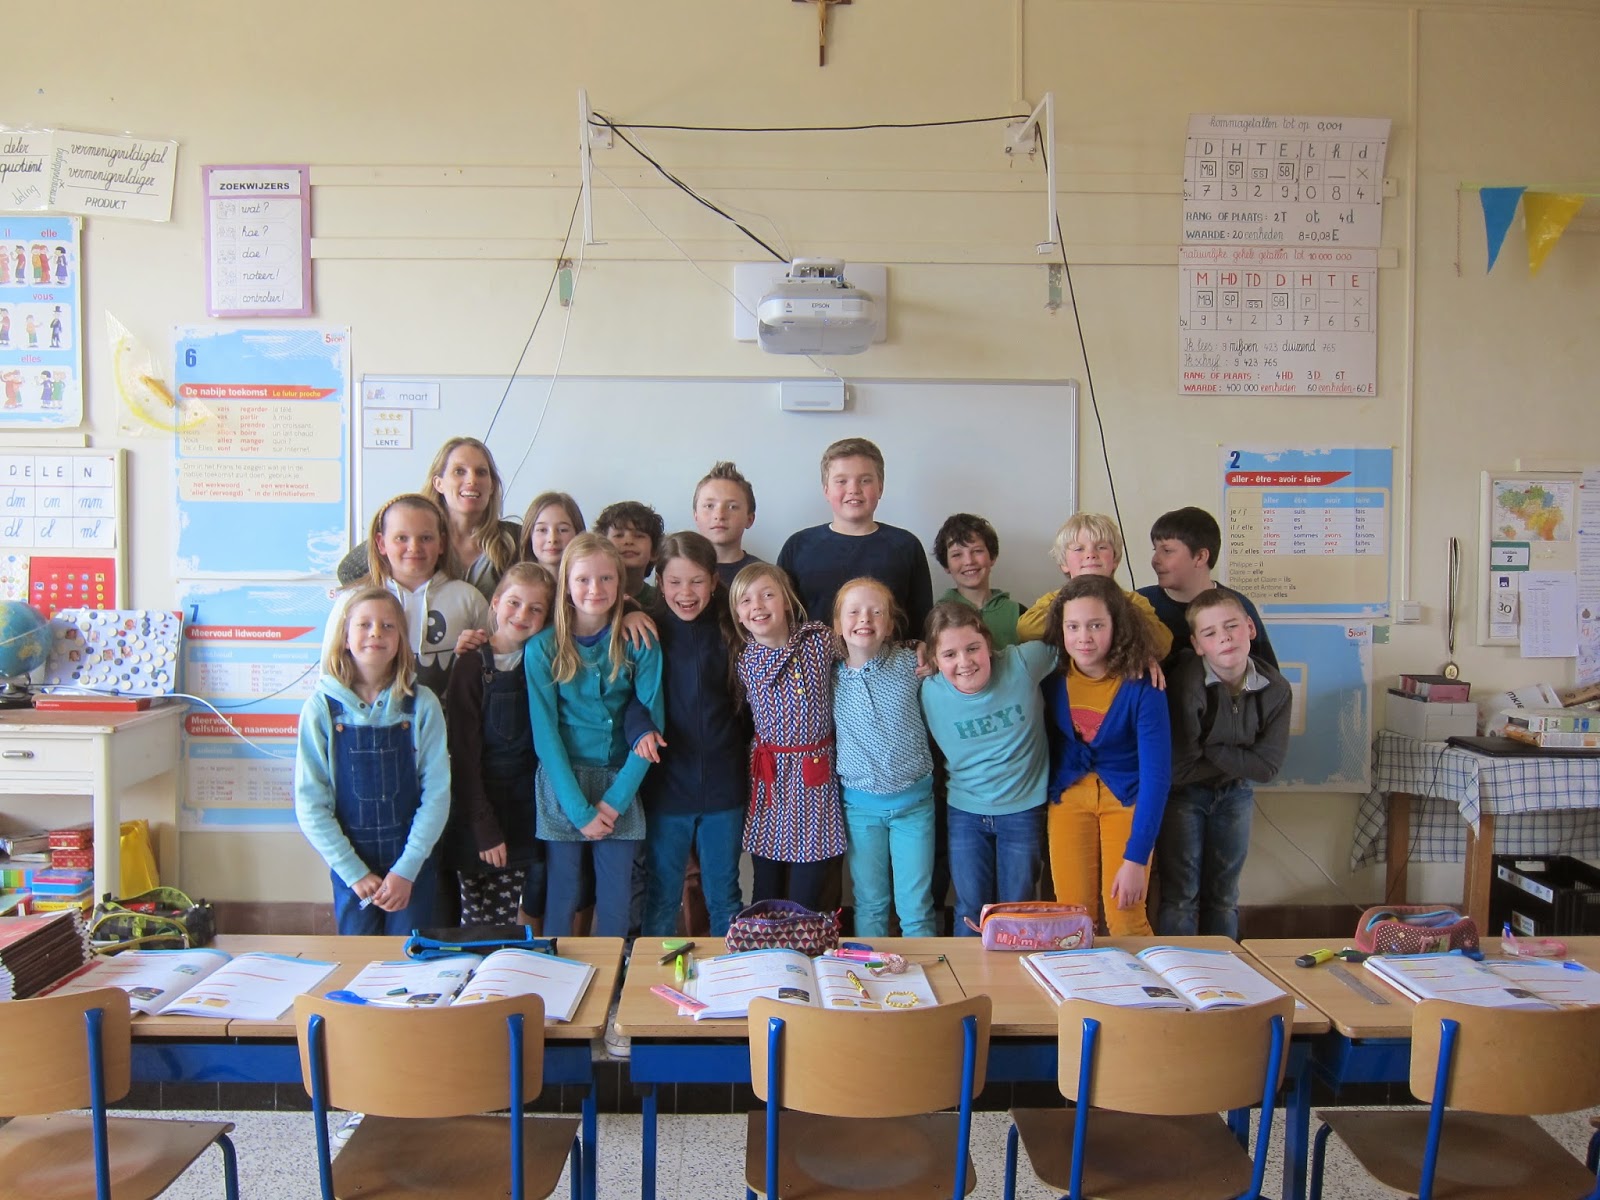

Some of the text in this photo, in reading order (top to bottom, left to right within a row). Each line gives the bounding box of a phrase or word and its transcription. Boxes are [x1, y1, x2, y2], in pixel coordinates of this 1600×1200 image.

[1210, 116, 1276, 132] kommagetallen
[1318, 122, 1342, 131] 0,001
[4, 137, 29, 154] deler
[1204, 142, 1213, 154] D
[1232, 143, 1242, 156] H
[1256, 143, 1267, 155] T
[1202, 185, 1210, 196] 7
[1231, 184, 1238, 197] 3
[1254, 185, 1262, 197] 2
[1332, 186, 1341, 200] 8
[1356, 187, 1364, 199] 4
[85, 197, 127, 210] PRODUCT
[1186, 212, 1212, 220] RANG
[41, 229, 58, 238] elle
[1197, 272, 1360, 288] M HD TD D H T E
[1227, 315, 1232, 324] 4
[1251, 315, 1257, 324] 2
[1276, 314, 1282, 325] 3
[1304, 315, 1310, 325] 7
[1328, 316, 1334, 326] 6
[1354, 316, 1360, 327] 5
[21, 355, 42, 363] elles
[185, 348, 197, 367] 6
[186, 387, 197, 395] De
[200, 387, 226, 397] nabije
[228, 388, 268, 396] toekomst
[1230, 450, 1240, 468] 2
[6, 488, 26, 508] dm
[79, 497, 102, 508] mm
[5, 518, 23, 538] dl
[80, 520, 101, 538] ml
[190, 604, 199, 622] 7
[1499, 602, 1512, 613] 30
[192, 629, 281, 638] Meervoud lidwoorden
[191, 716, 232, 725] Meervod
[954, 704, 1026, 740] HEY!
